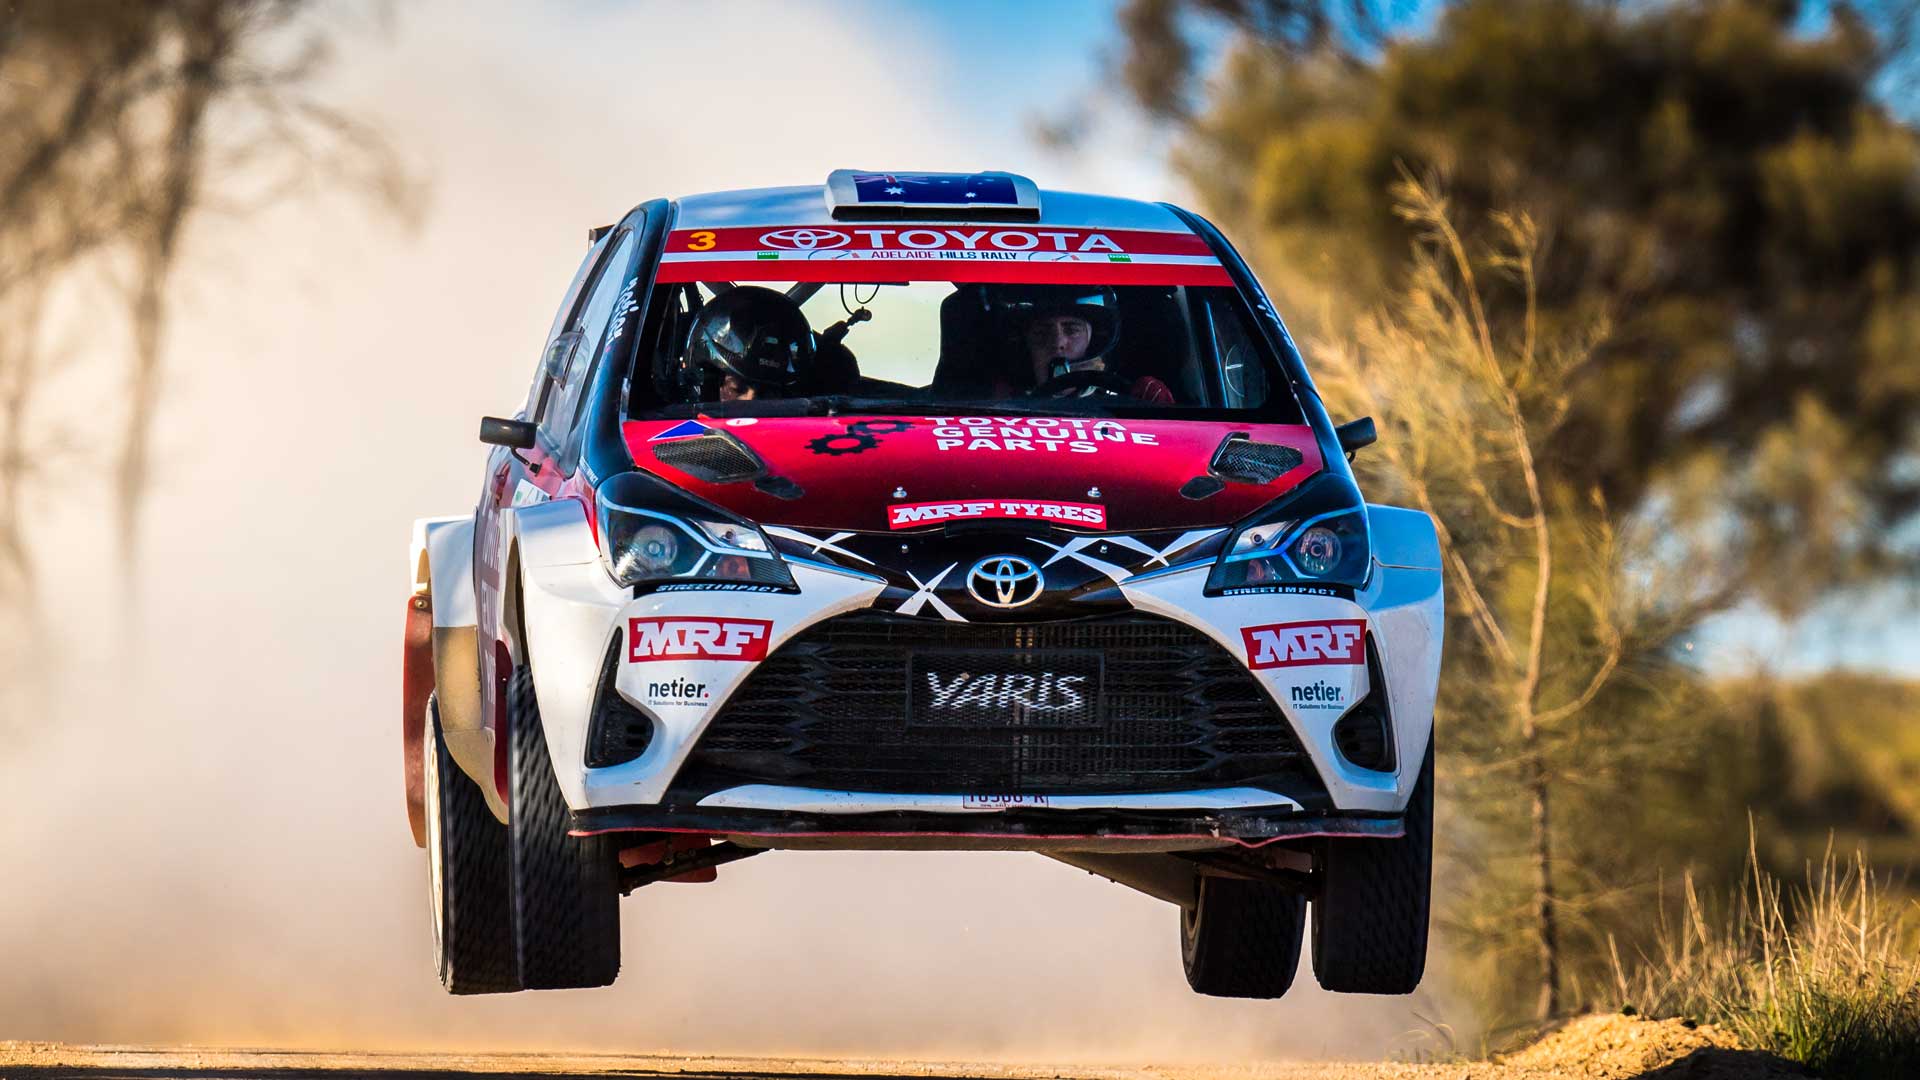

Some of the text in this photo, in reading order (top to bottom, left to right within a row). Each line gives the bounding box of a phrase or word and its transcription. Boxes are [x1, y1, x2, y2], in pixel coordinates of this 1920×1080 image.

[687, 231, 716, 250] 3
[854, 229, 1124, 253] TOYOTA
[871, 251, 1017, 260] ADELAIDE HILLS RALLY
[925, 417, 1126, 431] TOYOTA
[932, 427, 1159, 446] GENUINE
[936, 439, 1098, 453] PARTS
[892, 502, 1103, 524] MRF TYRES
[634, 621, 765, 657] MRF
[1252, 625, 1361, 664] MRF
[927, 672, 1087, 710] YARIS
